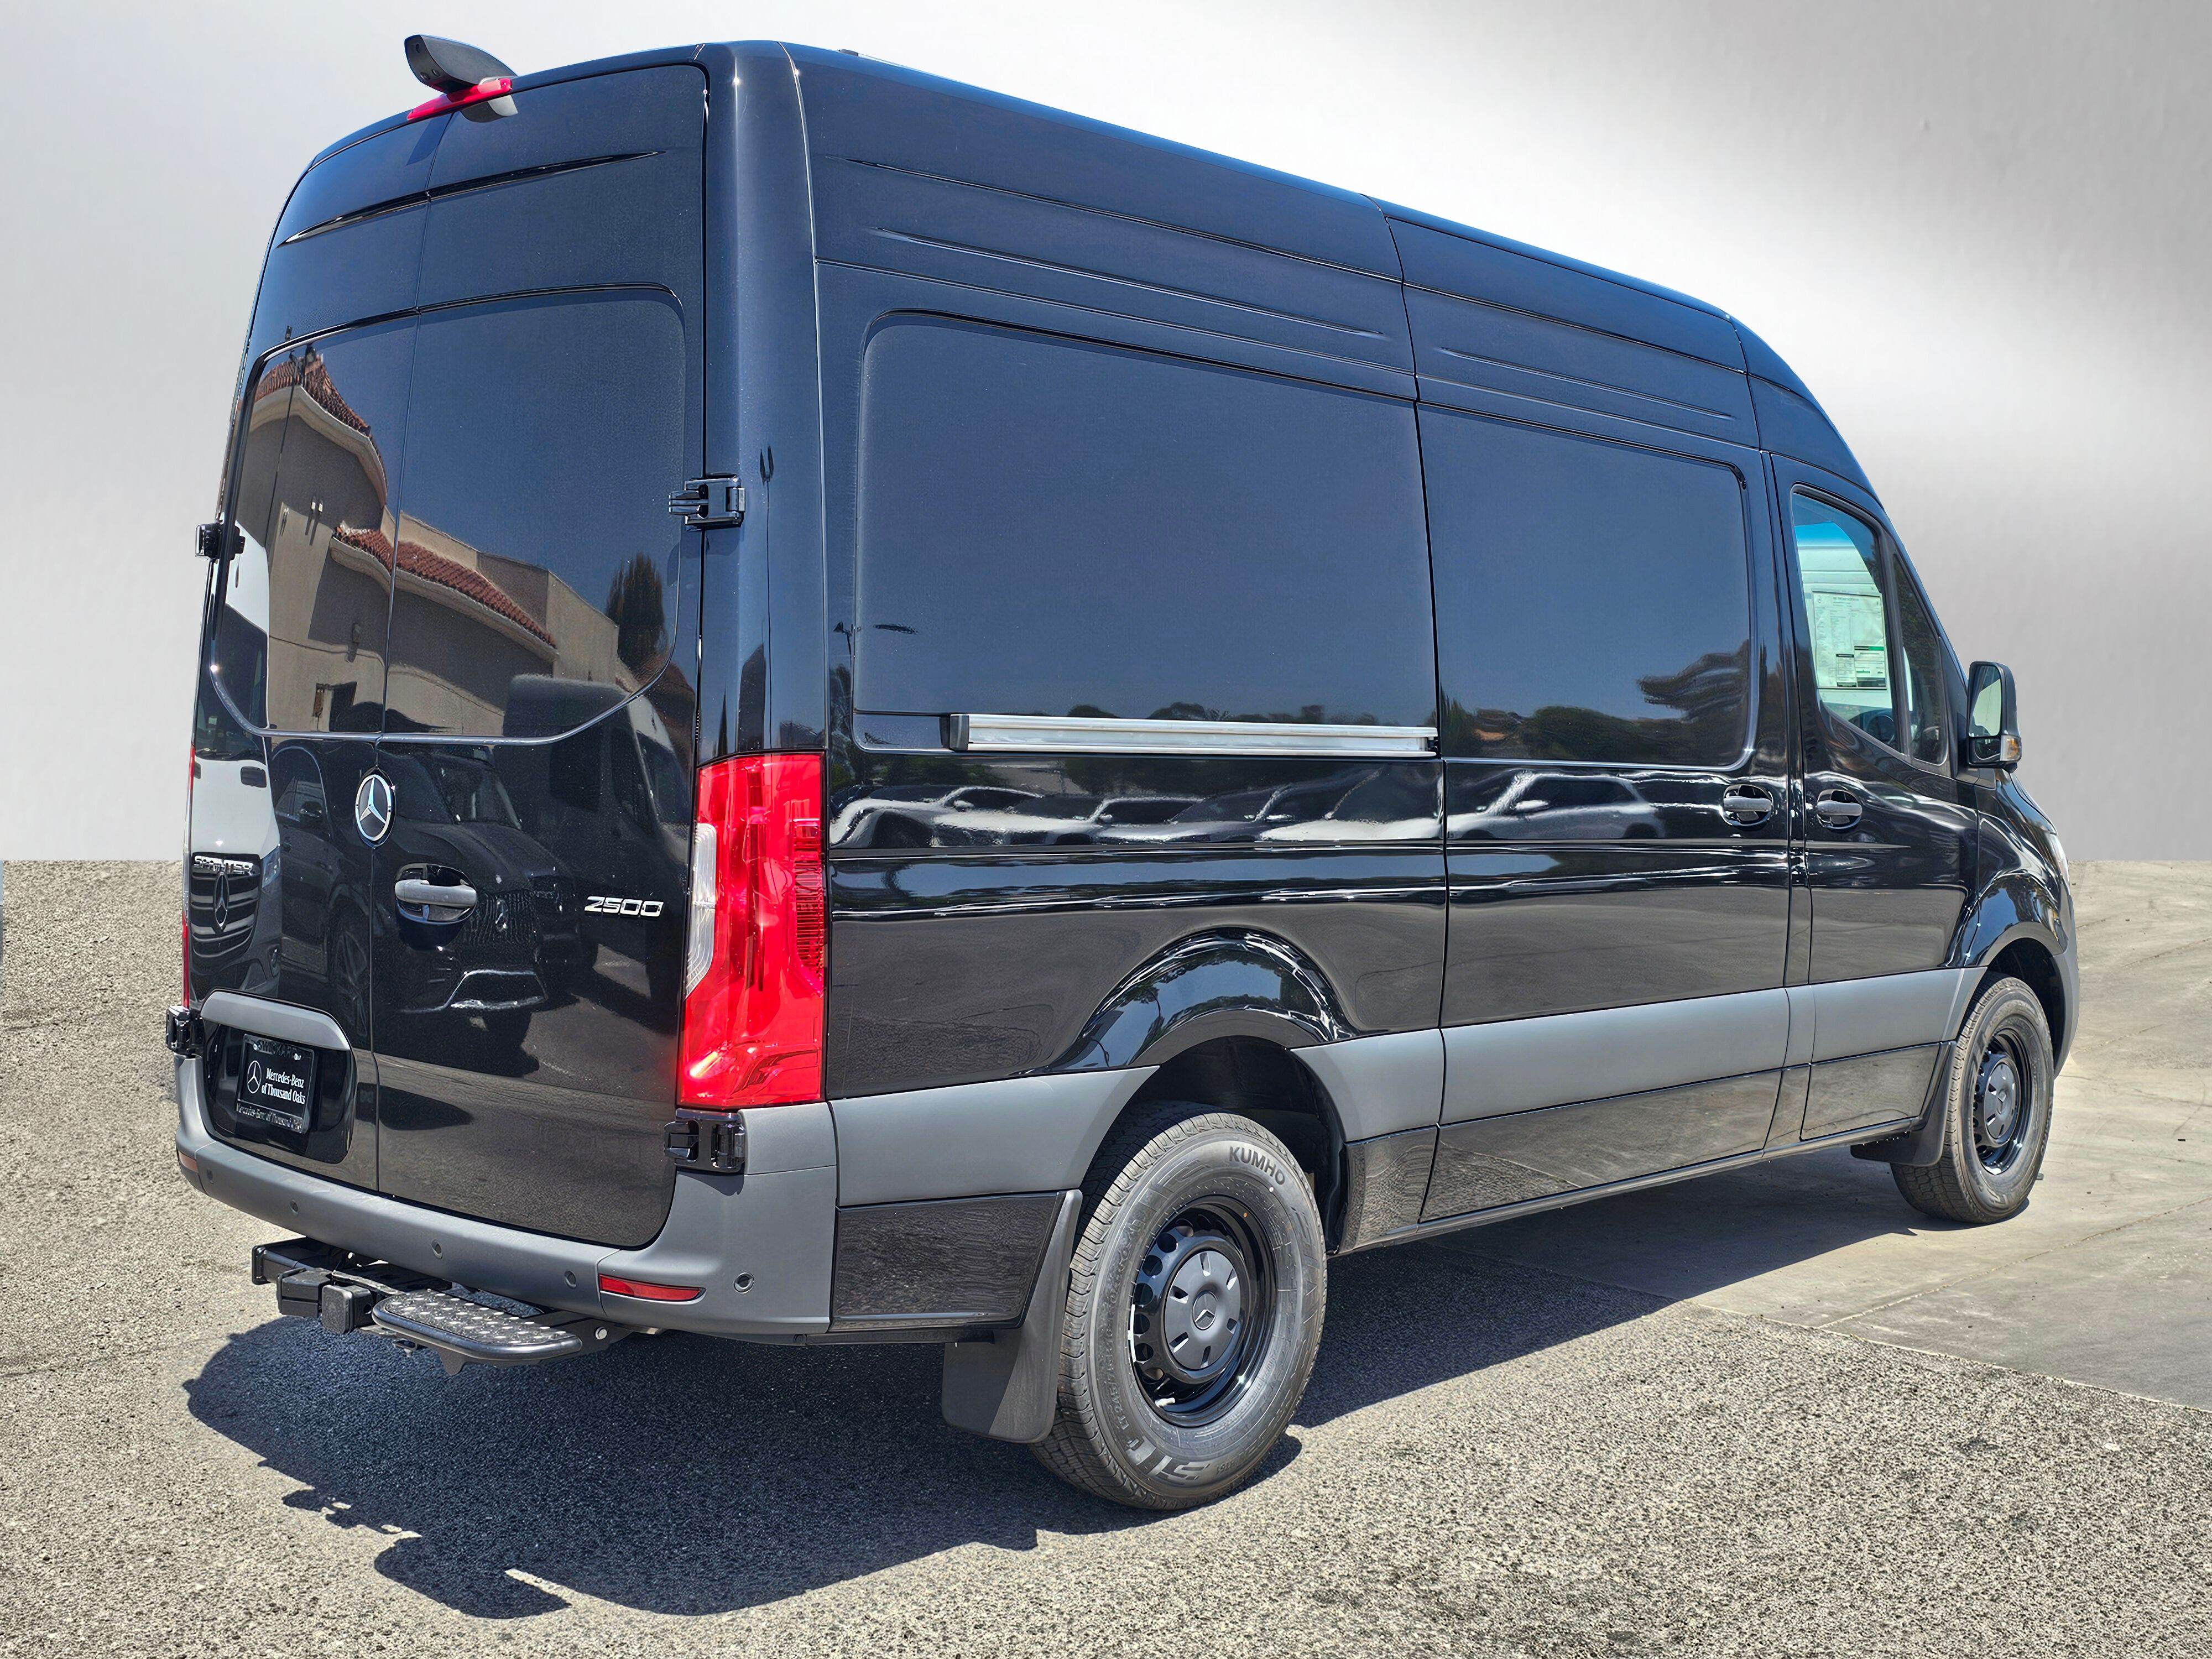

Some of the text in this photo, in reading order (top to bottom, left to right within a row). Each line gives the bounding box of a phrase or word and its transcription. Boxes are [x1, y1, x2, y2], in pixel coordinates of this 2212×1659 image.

[584, 896, 664, 917] 2500
[265, 1068, 305, 1088] Mercedes-Benz
[261, 1082, 306, 1104] of Thousand Oaks
[1228, 1146, 1286, 1186] KUMHO
